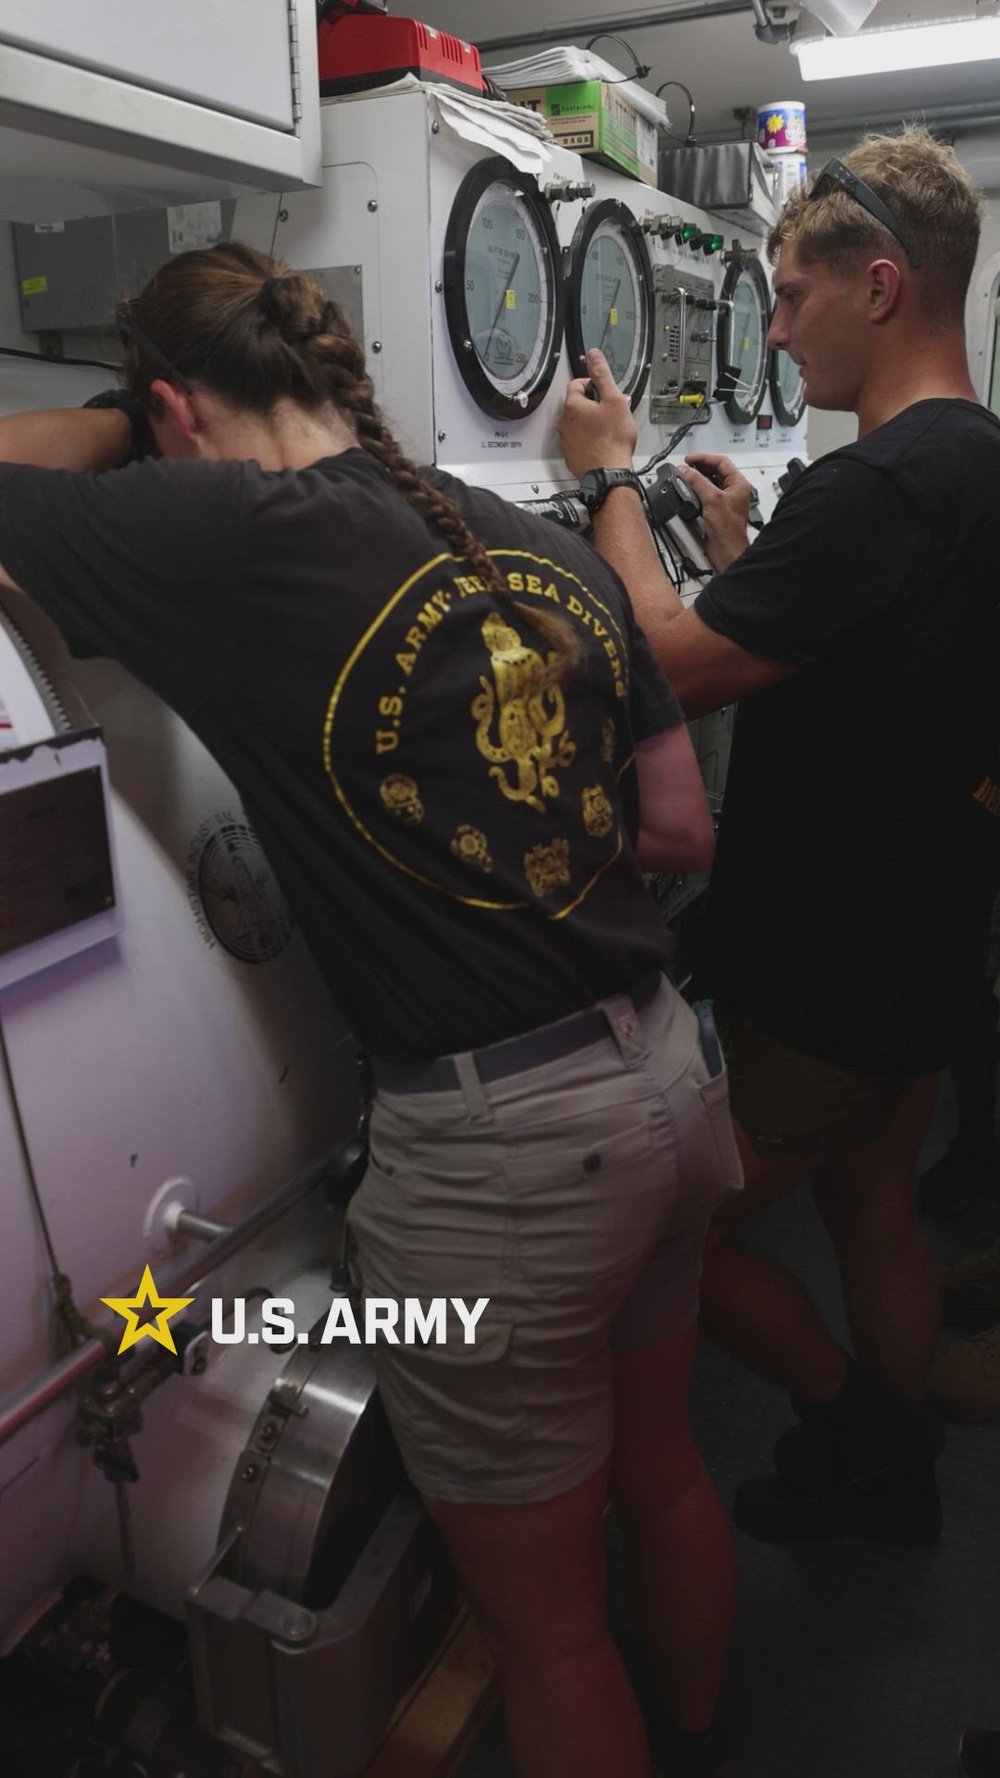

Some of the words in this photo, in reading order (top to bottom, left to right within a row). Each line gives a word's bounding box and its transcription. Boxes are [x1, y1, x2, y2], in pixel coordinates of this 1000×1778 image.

[563, 136, 589, 145] BAGS
[482, 217, 493, 230] 100
[515, 229, 526, 240] 150
[466, 280, 475, 291] 50
[528, 292, 539, 304] 200
[395, 591, 450, 676] ARMY
[507, 572, 561, 603] SEA
[566, 594, 628, 698] DIVERS
